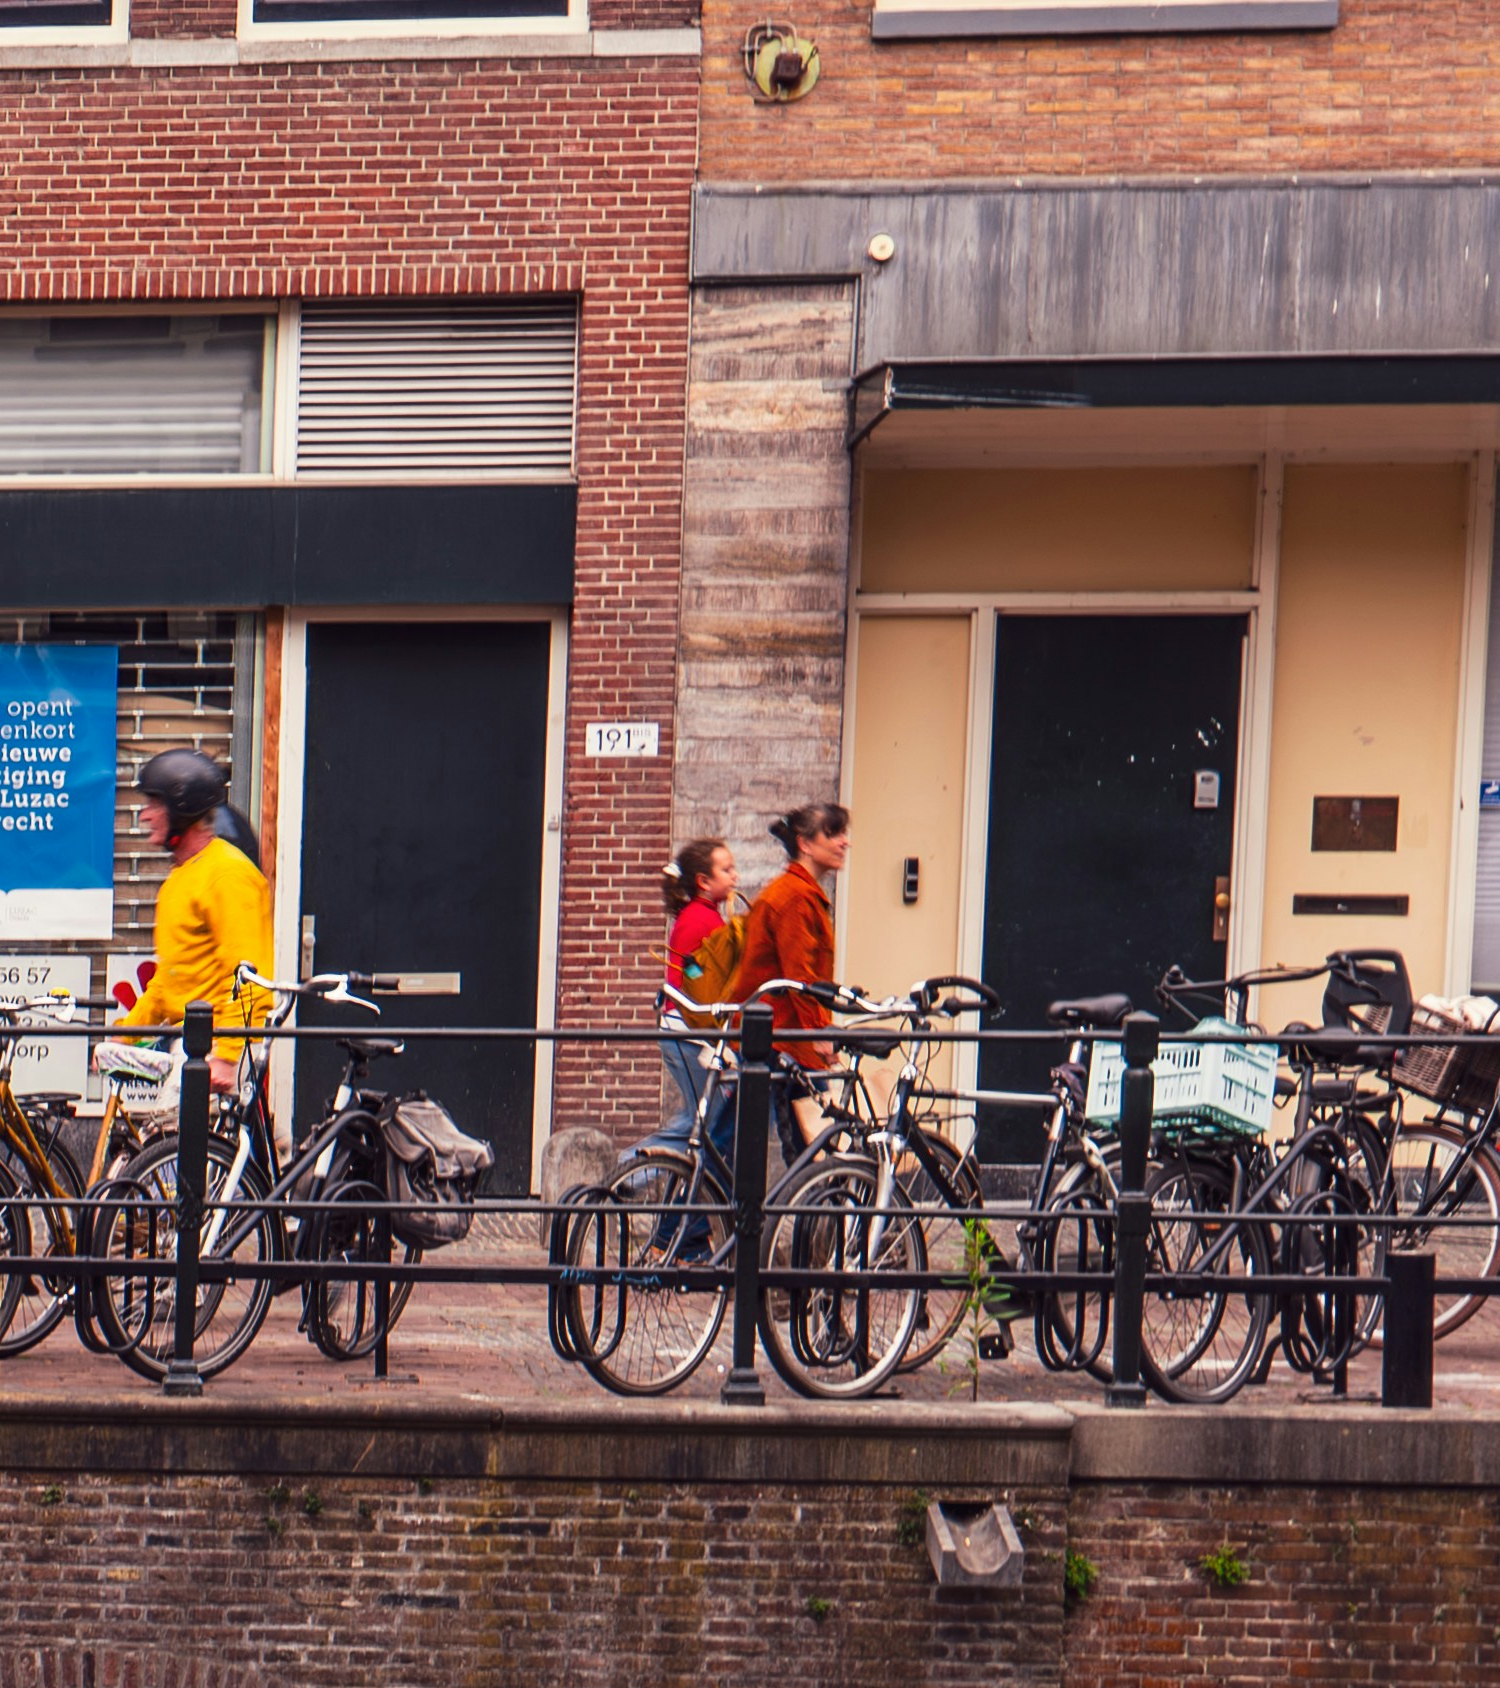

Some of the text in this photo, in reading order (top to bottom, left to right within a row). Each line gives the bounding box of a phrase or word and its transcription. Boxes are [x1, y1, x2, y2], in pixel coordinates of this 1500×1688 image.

[7, 699, 73, 721] opent
[597, 729, 631, 752] 191
[0, 789, 69, 808] Luzac
[27, 967, 51, 984] 57
